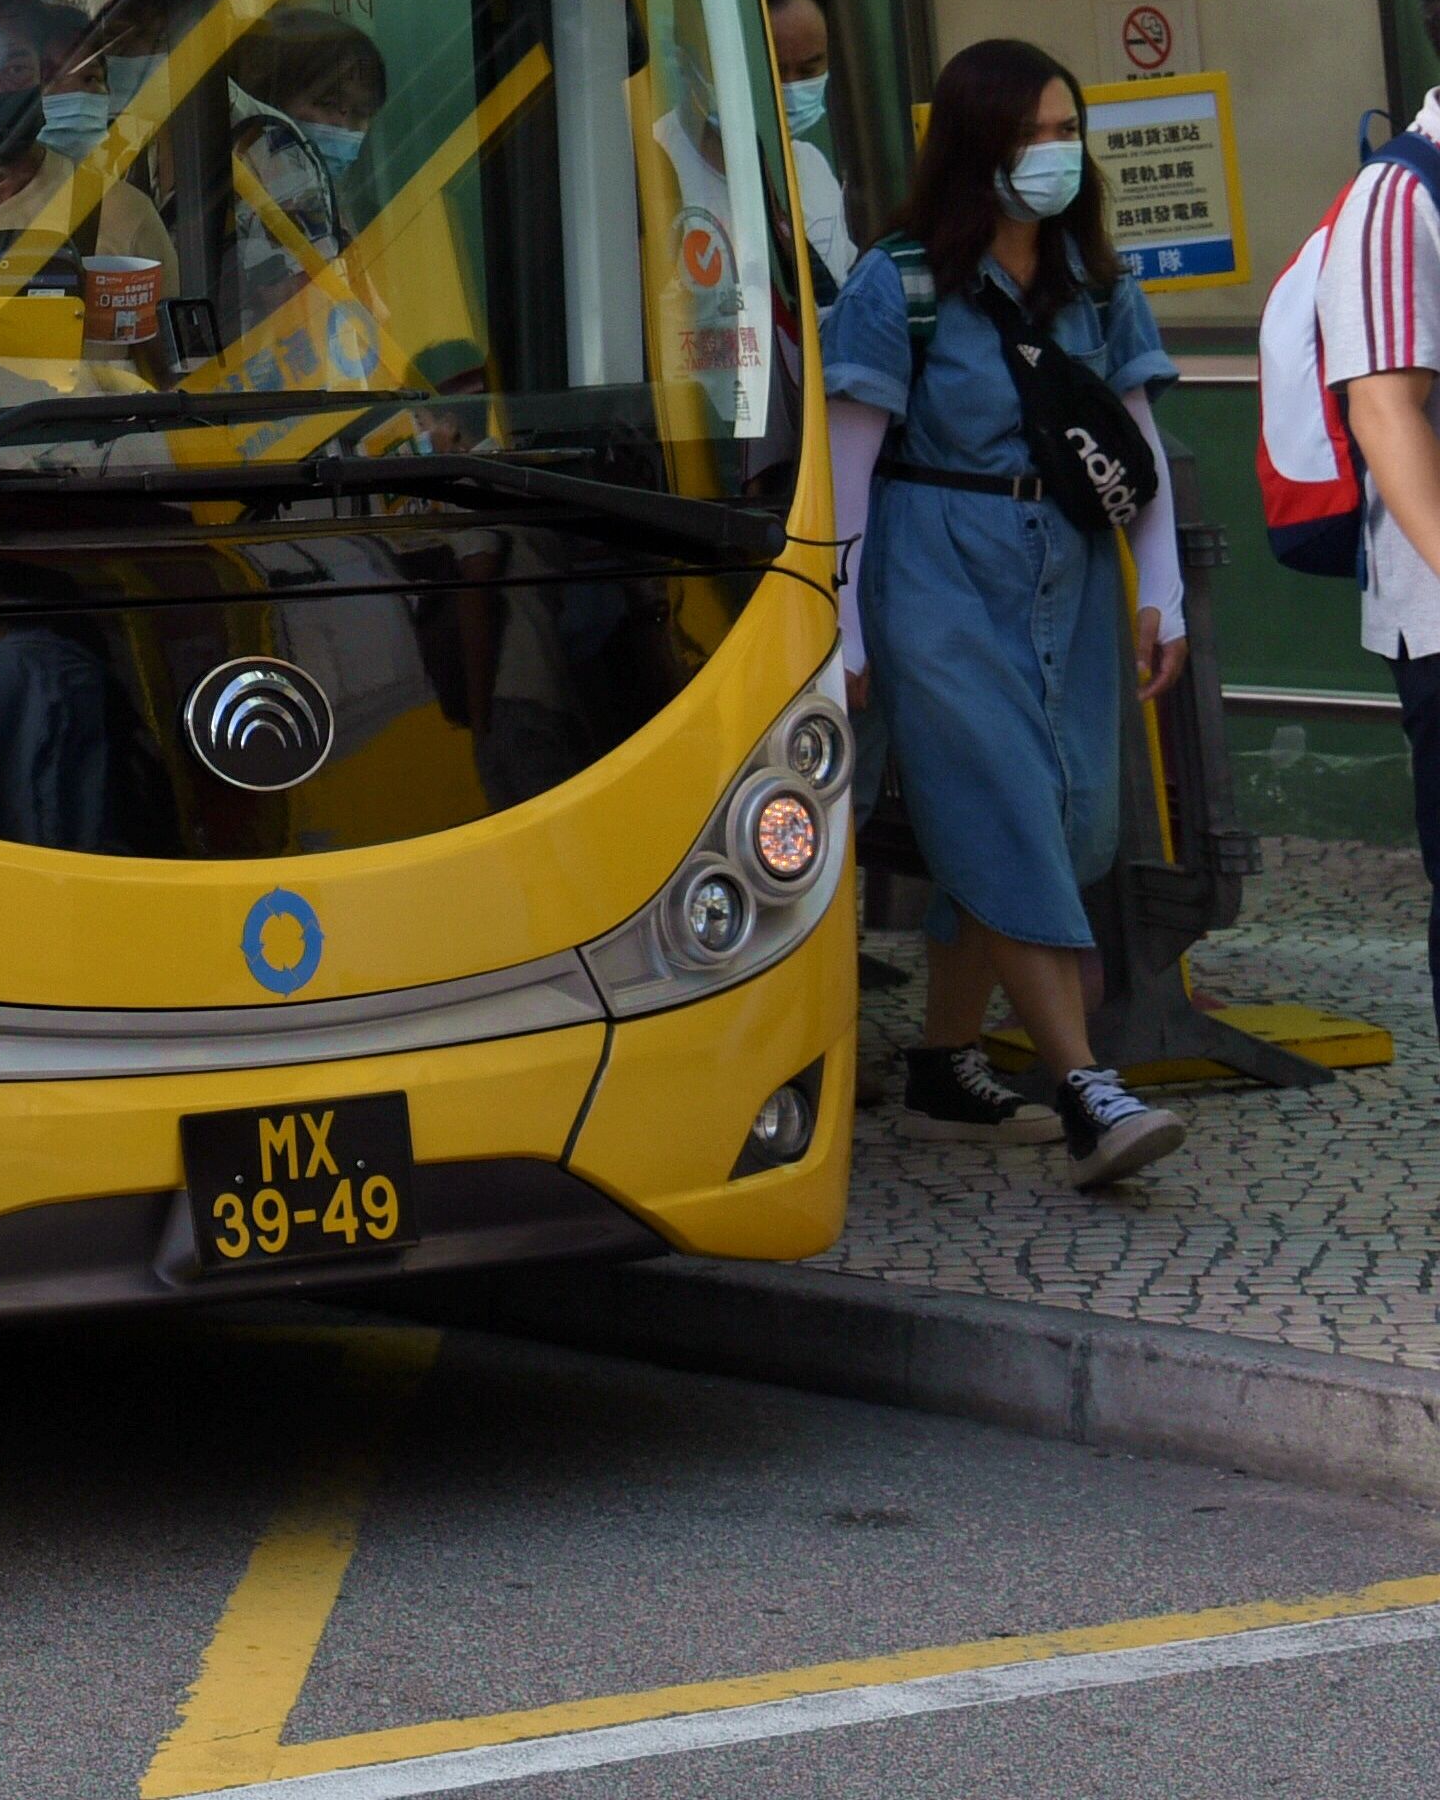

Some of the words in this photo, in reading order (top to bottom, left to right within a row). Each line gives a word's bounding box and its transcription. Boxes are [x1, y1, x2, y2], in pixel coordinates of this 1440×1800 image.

[1064, 426, 1139, 526] adida
[257, 1110, 340, 1183] MX
[211, 1174, 400, 1260] 39-49
